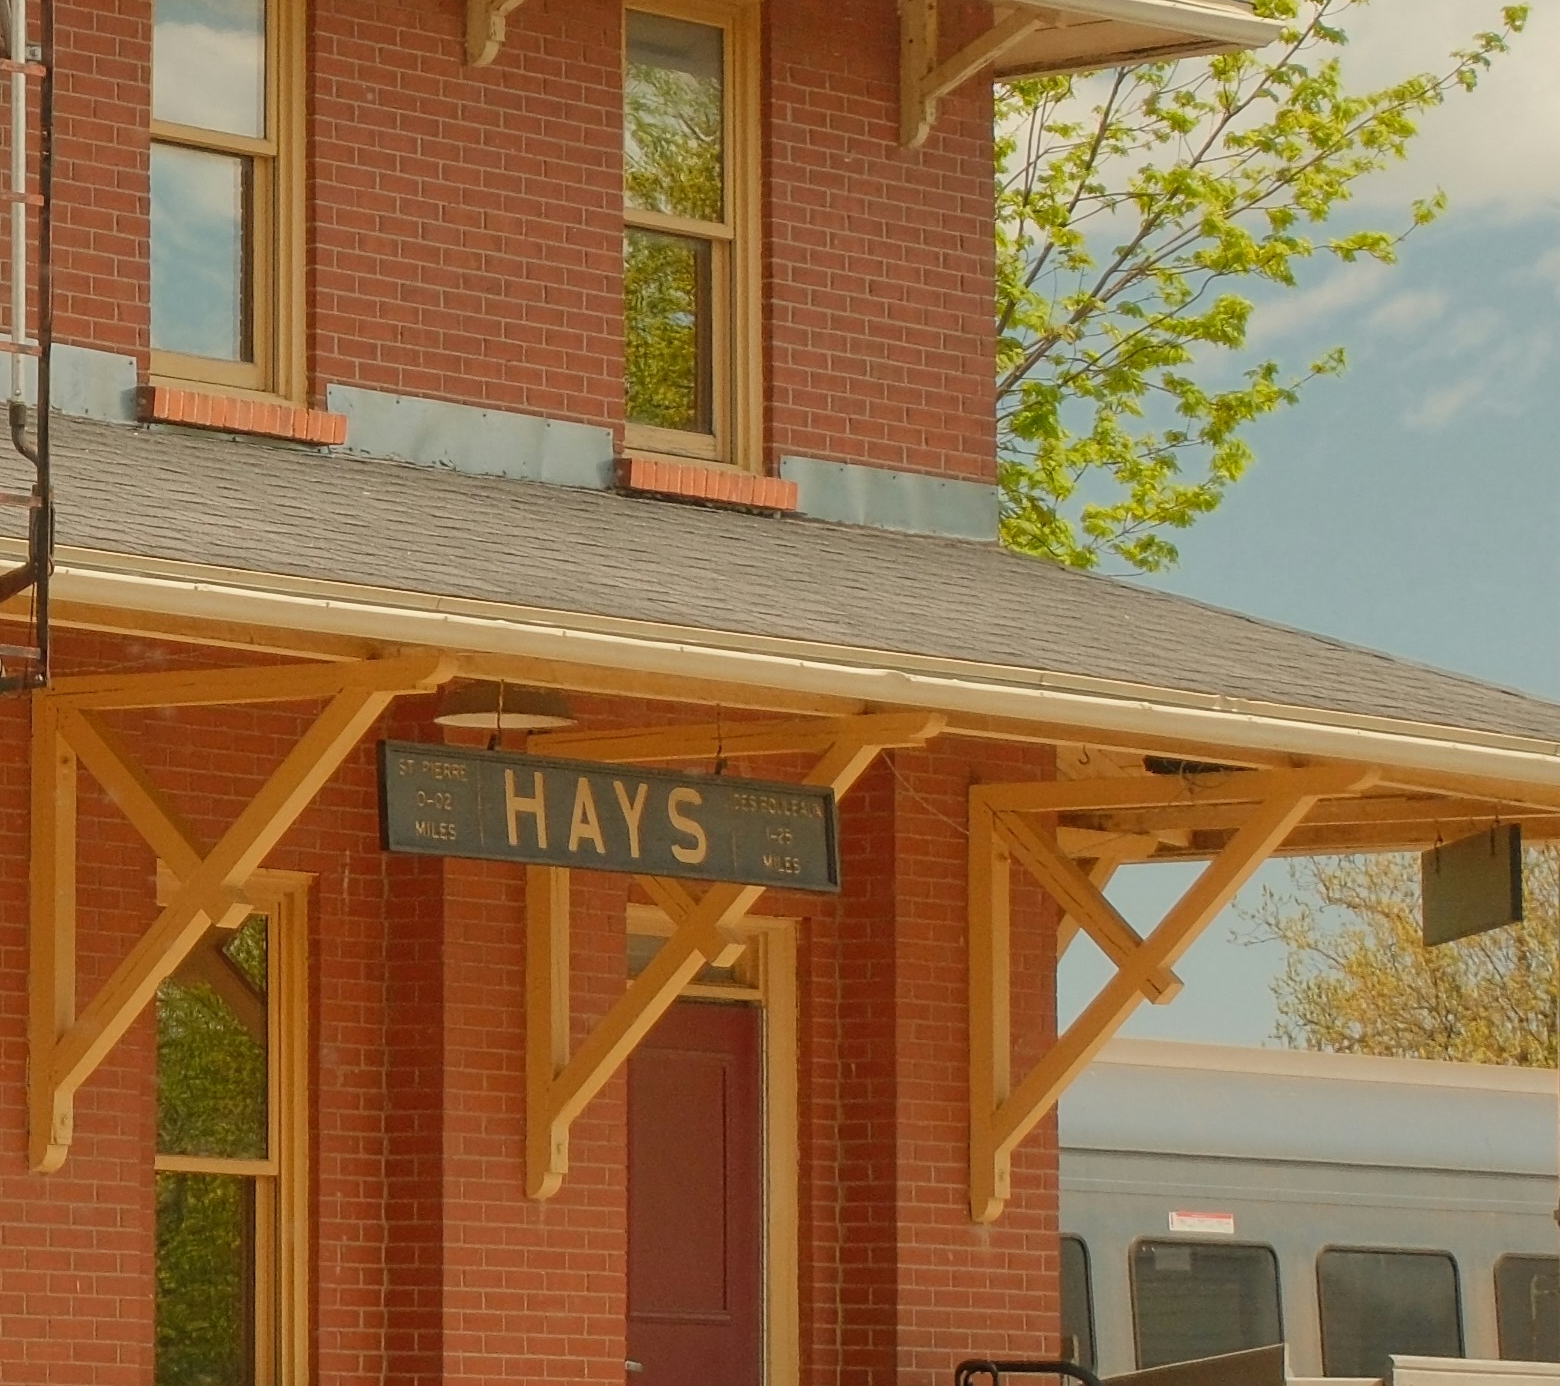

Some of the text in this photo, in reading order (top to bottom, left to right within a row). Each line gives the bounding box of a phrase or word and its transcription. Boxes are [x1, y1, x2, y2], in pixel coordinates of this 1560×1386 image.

[421, 760, 469, 782] PIERRE
[504, 768, 709, 865] HAYS
[415, 820, 458, 841] MILES
[761, 853, 802, 875] MILES
